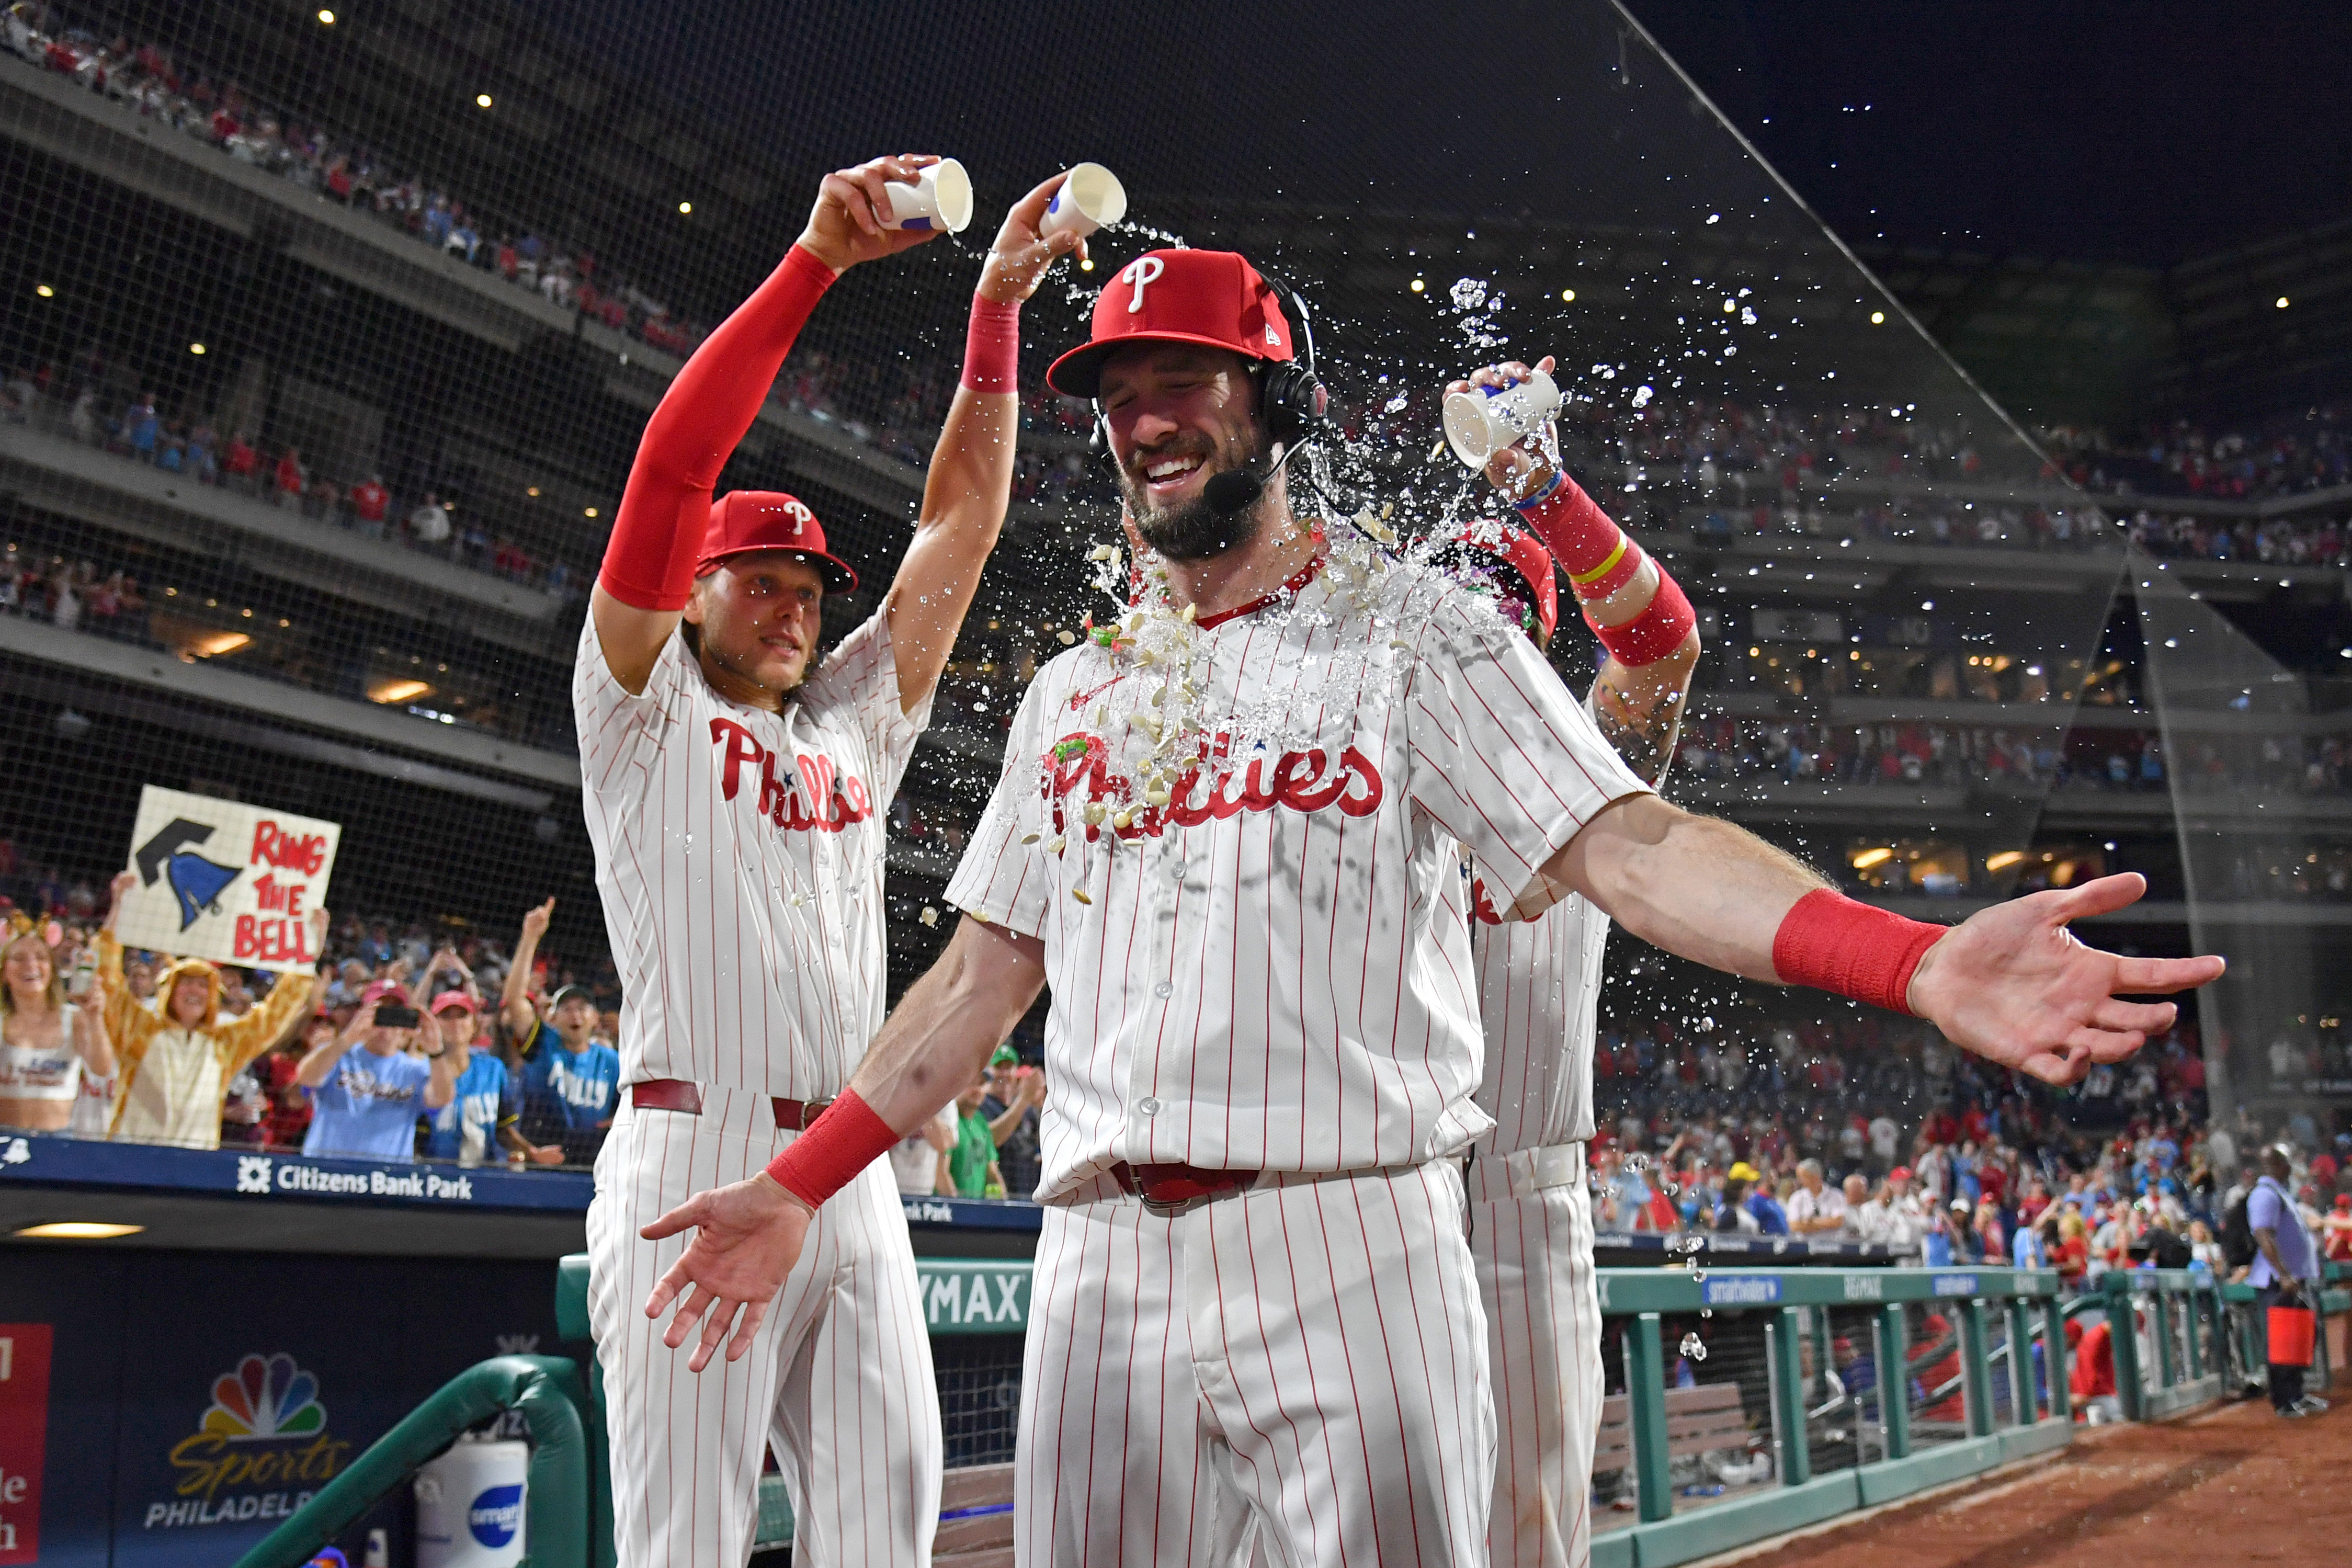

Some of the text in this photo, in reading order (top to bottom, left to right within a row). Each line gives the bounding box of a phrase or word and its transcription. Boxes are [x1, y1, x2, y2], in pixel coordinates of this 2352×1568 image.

[1122, 257, 1165, 313] P
[783, 501, 811, 535] P
[709, 717, 872, 833] Phillie
[251, 820, 326, 877] RING
[254, 873, 306, 916] THE
[234, 914, 315, 964] BELL
[277, 1164, 473, 1200] Citizens Bank Park
[923, 1202, 952, 1223] Park
[169, 1429, 349, 1501] Sports
